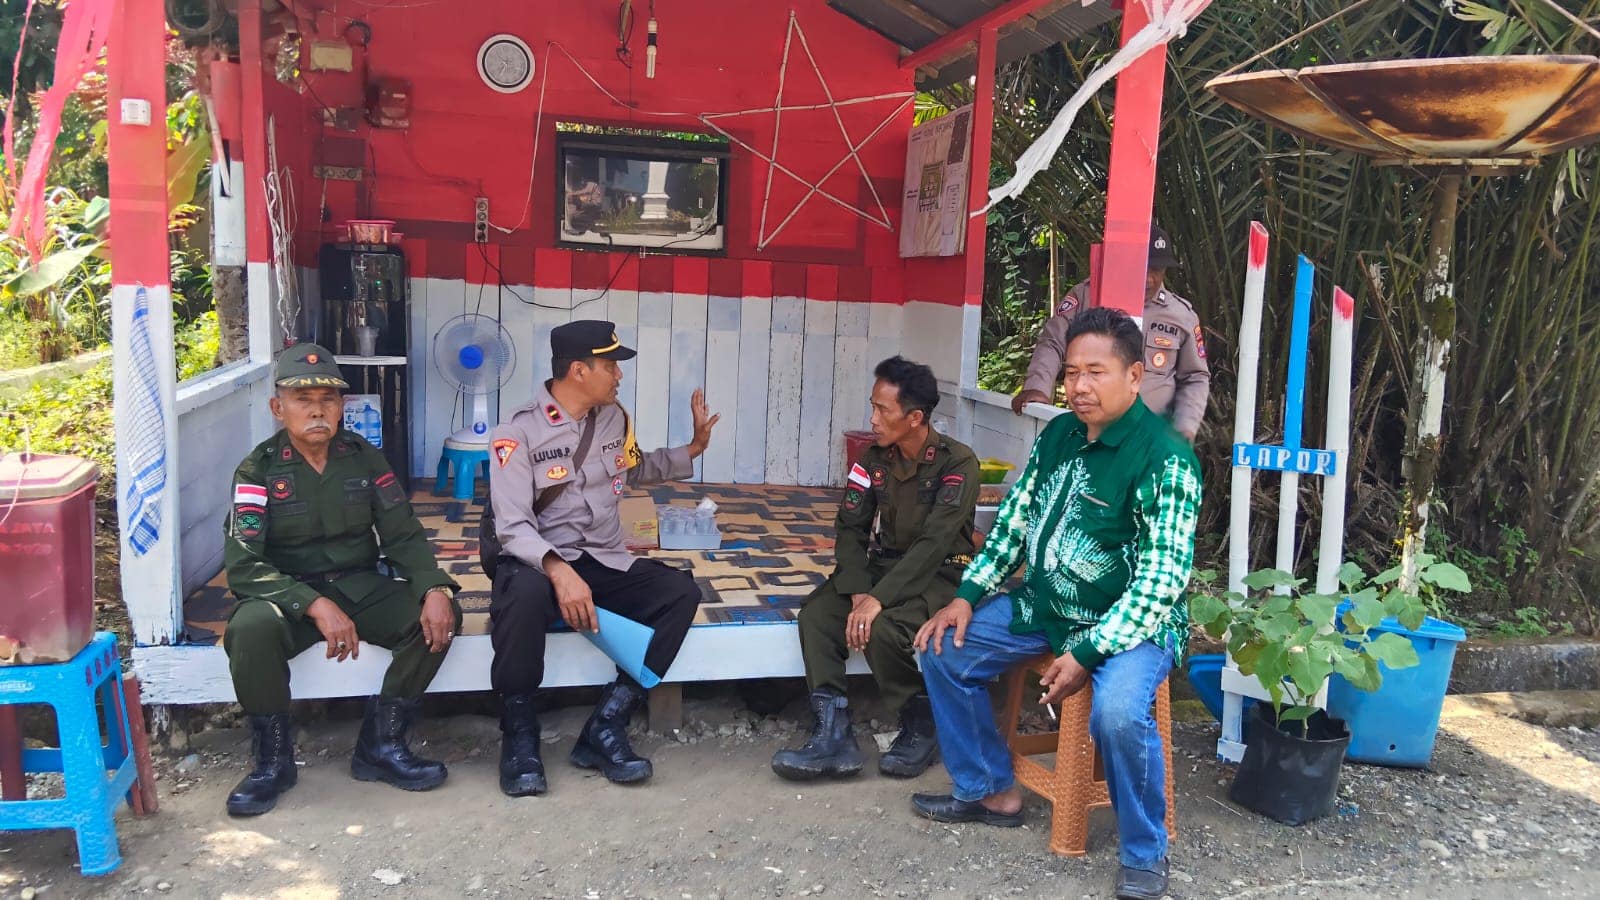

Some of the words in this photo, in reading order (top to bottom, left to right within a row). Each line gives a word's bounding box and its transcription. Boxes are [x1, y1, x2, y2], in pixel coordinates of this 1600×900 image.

[1150, 322, 1178, 336] POLRI
[533, 446, 571, 463] LULUS.P
[1237, 445, 1331, 475] LAPOR
